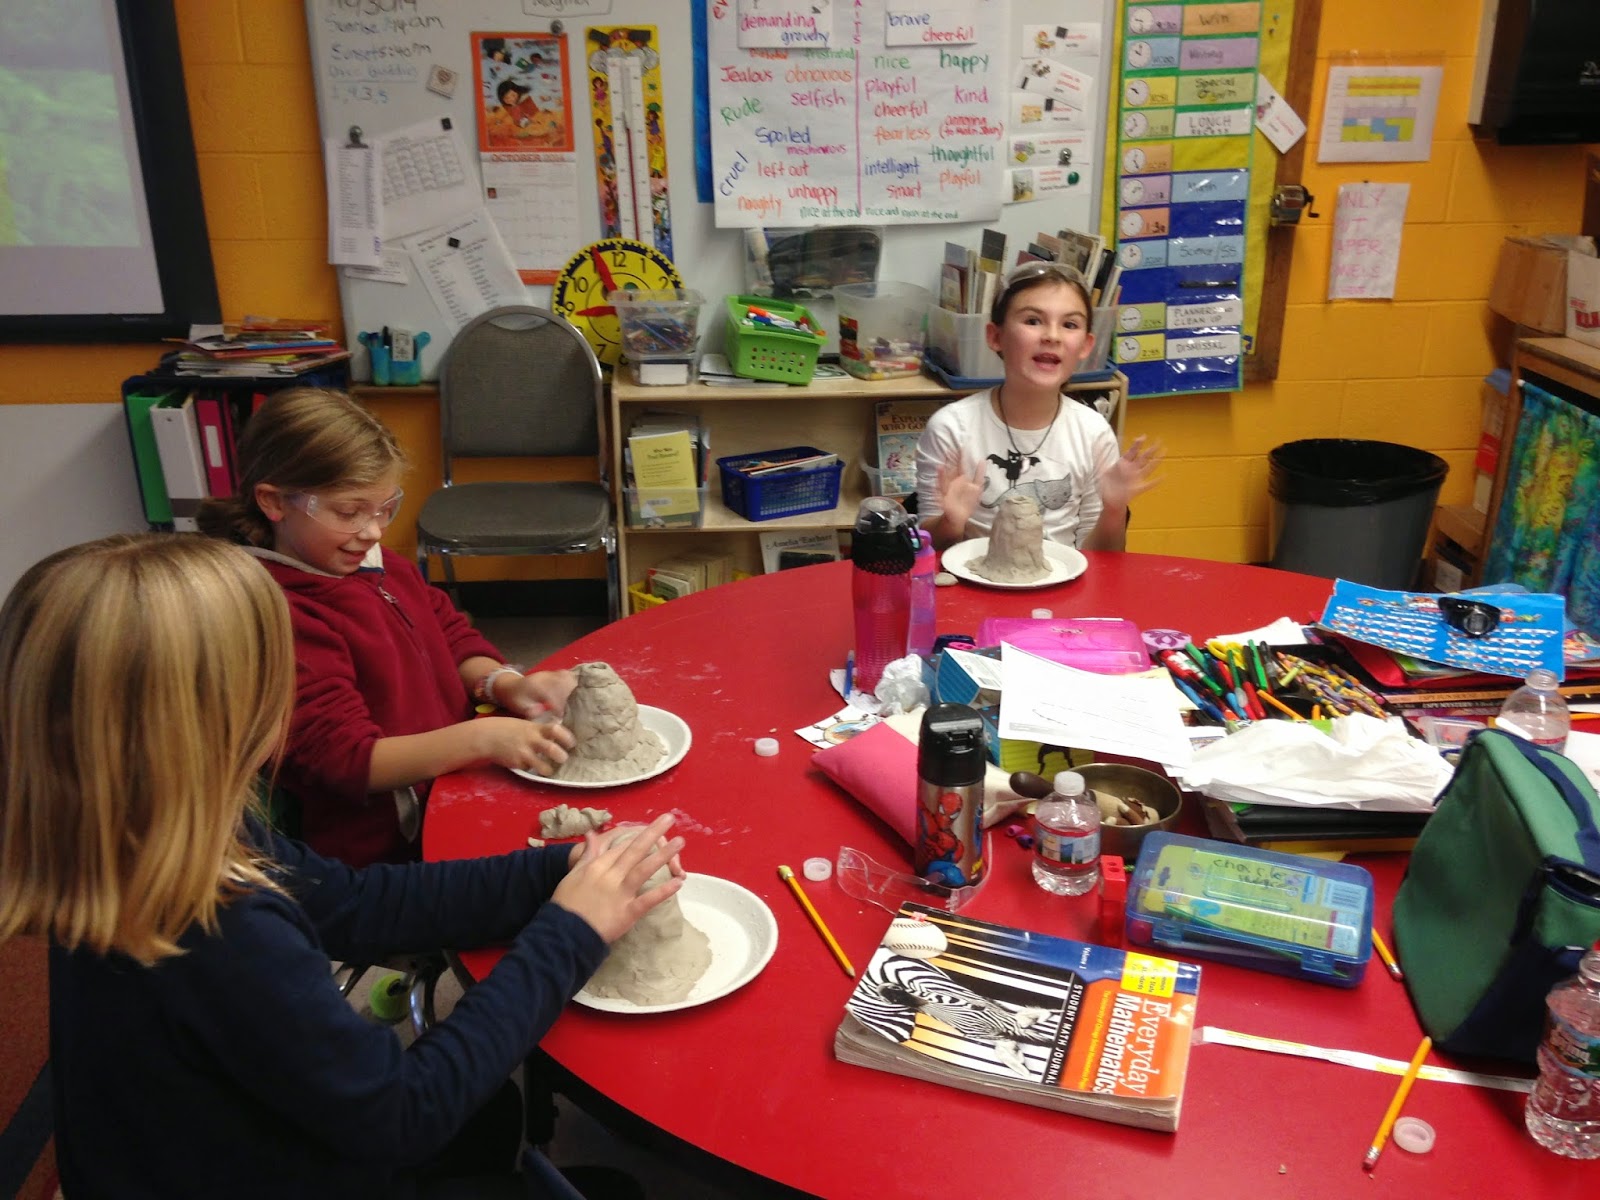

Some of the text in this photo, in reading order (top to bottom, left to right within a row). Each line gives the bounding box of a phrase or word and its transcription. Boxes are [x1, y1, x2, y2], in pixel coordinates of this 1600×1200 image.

[741, 10, 818, 34] demanding
[887, 10, 931, 27] brave
[922, 26, 974, 42] cheerful
[874, 55, 911, 69] nice
[939, 48, 989, 74] happy
[720, 65, 774, 83] Jealous
[791, 88, 847, 107] selfish
[864, 76, 917, 101] playful
[720, 96, 763, 126] Rude
[874, 99, 928, 119] cheerful
[755, 126, 811, 147] Spoiled
[874, 126, 931, 145] fearless
[928, 144, 994, 169] thoughtful
[720, 150, 749, 196] cruel
[757, 160, 810, 177] left out
[864, 156, 920, 179] intelligent
[885, 180, 922, 199] smart
[940, 168, 983, 193] playful
[787, 184, 838, 207] unhappy
[612, 251, 627, 268] 12
[573, 276, 589, 294] 10
[564, 301, 576, 318] 9
[1045, 984, 1083, 1085] STUDENT MATH JOURNAL
[1092, 992, 1143, 1095] Mathematics
[1120, 998, 1173, 1095] Everyday
